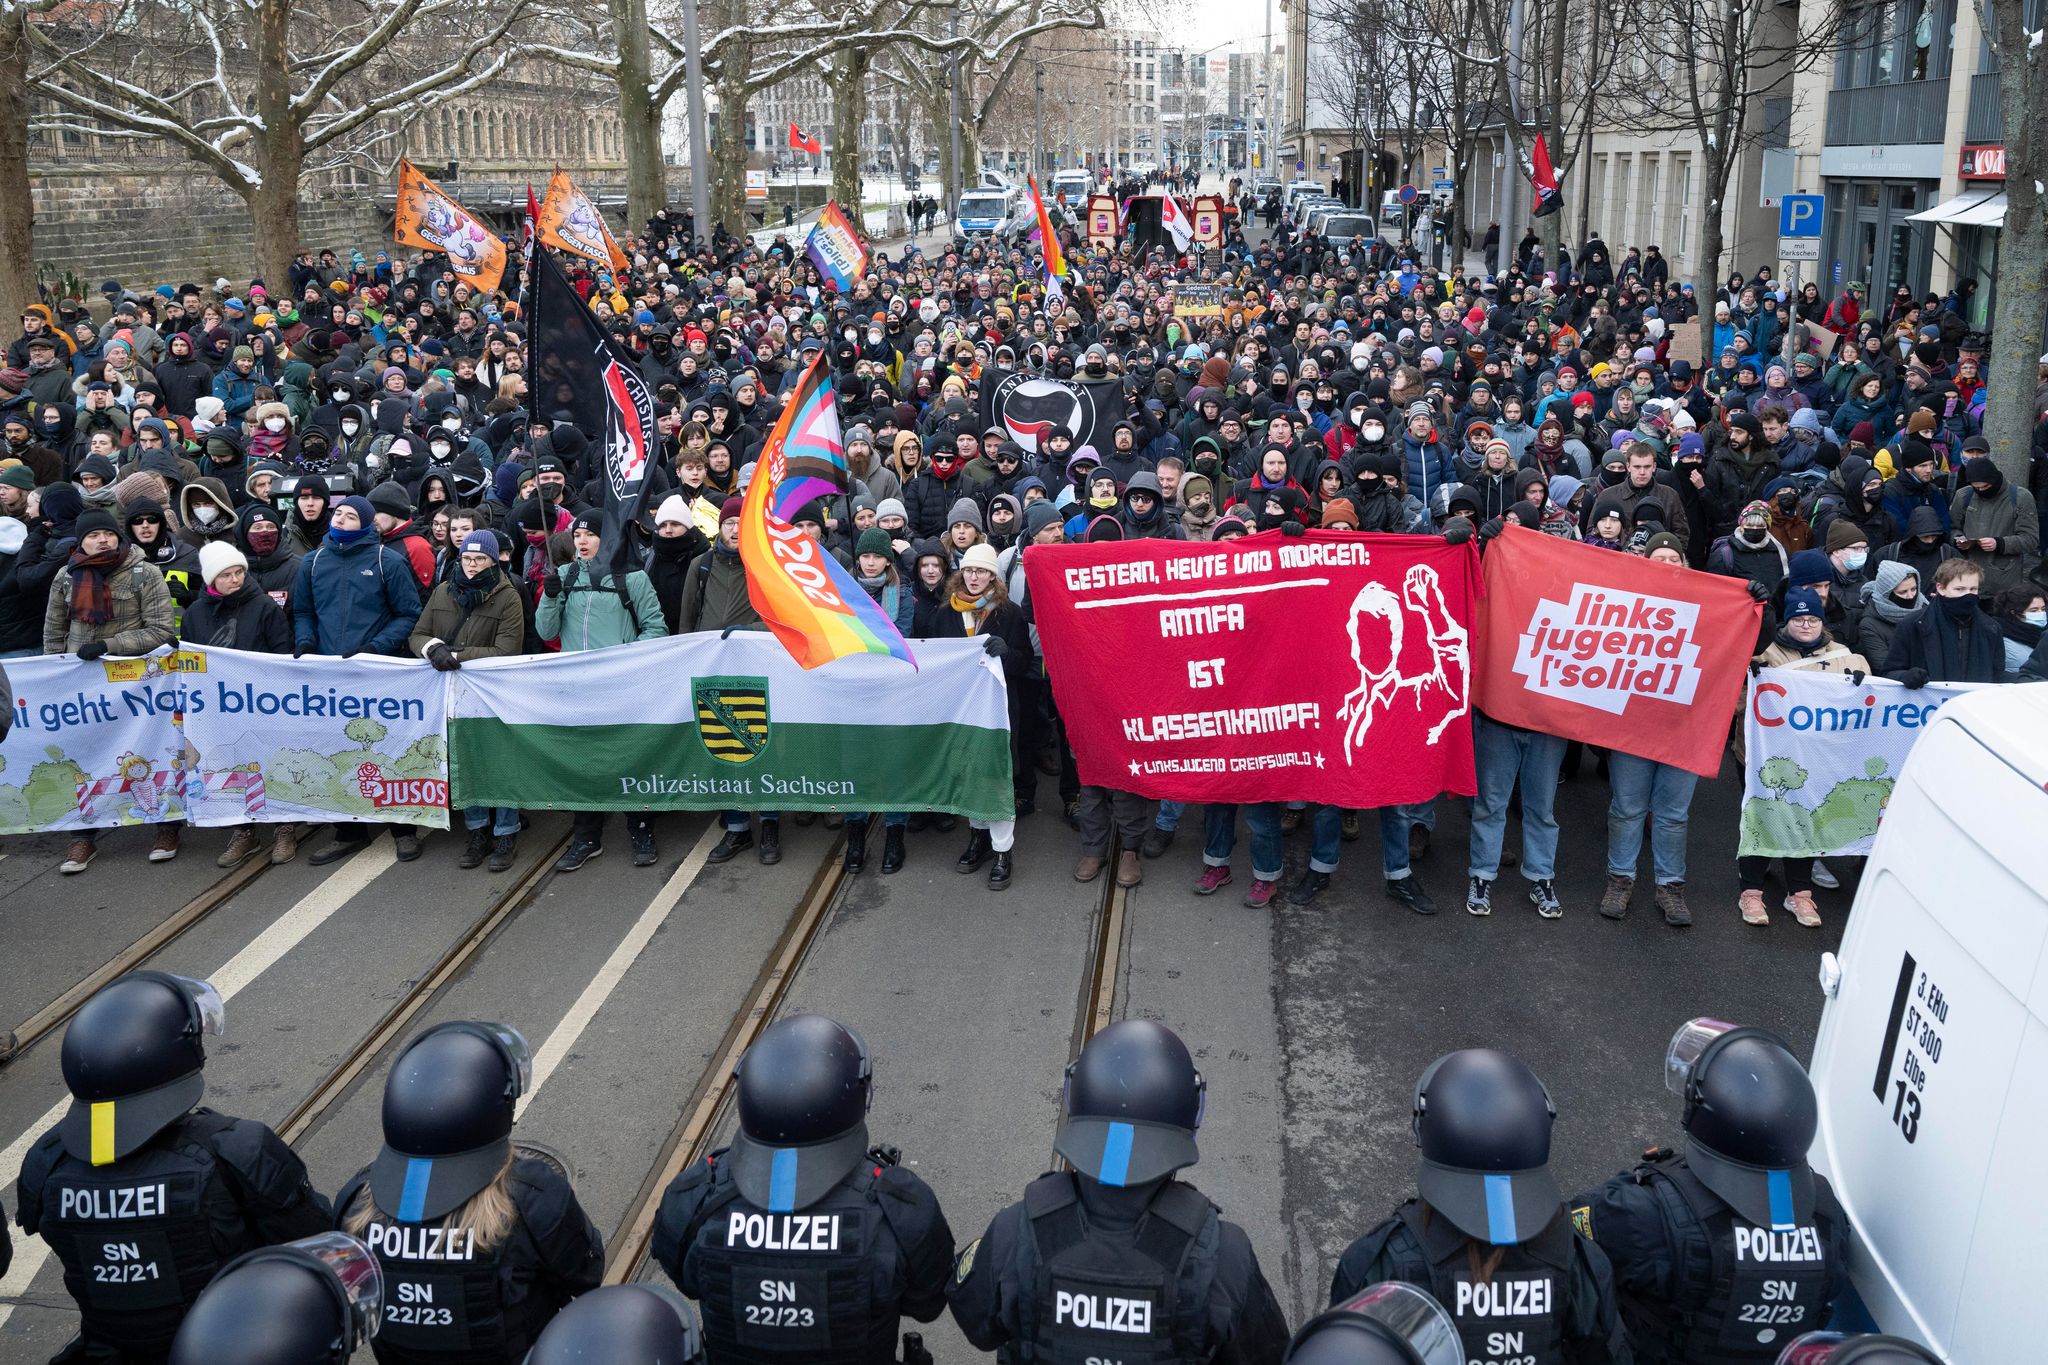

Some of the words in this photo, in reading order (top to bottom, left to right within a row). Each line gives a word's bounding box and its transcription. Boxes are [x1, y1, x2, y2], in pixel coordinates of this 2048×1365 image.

[1790, 201, 1814, 231] P
[558, 229, 584, 250] GEGEN
[608, 443, 625, 492] AKTIO
[1065, 560, 1160, 591] GESTERN,
[1165, 554, 1228, 581] HEUTE
[1234, 550, 1272, 575] UND
[1278, 543, 1370, 569] MORGEN:
[1159, 603, 1245, 637] ANTIFA
[1575, 592, 1677, 632] links
[1530, 617, 1688, 661] jugend
[111, 671, 138, 679] Freundin
[114, 662, 134, 671] Meine
[1187, 658, 1226, 688] IST
[40, 692, 118, 732] geht
[121, 683, 205, 717] Nais
[218, 681, 424, 721] blockieren
[1122, 702, 1320, 742] KLASSENKAMPF!
[1753, 682, 1876, 731] Conni
[1143, 758, 1226, 774] LINKSJUGEND
[1230, 751, 1312, 772] GREIFSWALD
[381, 780, 445, 805] JUSOS
[619, 773, 752, 795] Polizeistaat
[760, 773, 856, 795] Sachsen
[1906, 1005, 1921, 1038] ST
[1919, 1021, 1943, 1064] 300
[1903, 1048, 1926, 1092] Elbe
[1892, 1079, 1922, 1144] 13
[60, 1183, 165, 1219] POLIZEI
[367, 1222, 475, 1260] POLIZEI
[727, 1211, 840, 1250] POLIZEI
[1734, 1226, 1823, 1262] POLIZEI
[102, 1242, 140, 1261] SN
[93, 1261, 160, 1283] 22/21
[398, 1282, 433, 1303] SN
[759, 1279, 796, 1302] SN
[1456, 1278, 1552, 1317] POLIZEI
[1760, 1280, 1797, 1301] SN
[385, 1305, 453, 1325] 22/23
[745, 1305, 815, 1327] 22/23
[1056, 1290, 1151, 1333] POLIZEI
[1737, 1304, 1806, 1324] 22/23
[1486, 1331, 1524, 1356] SN
